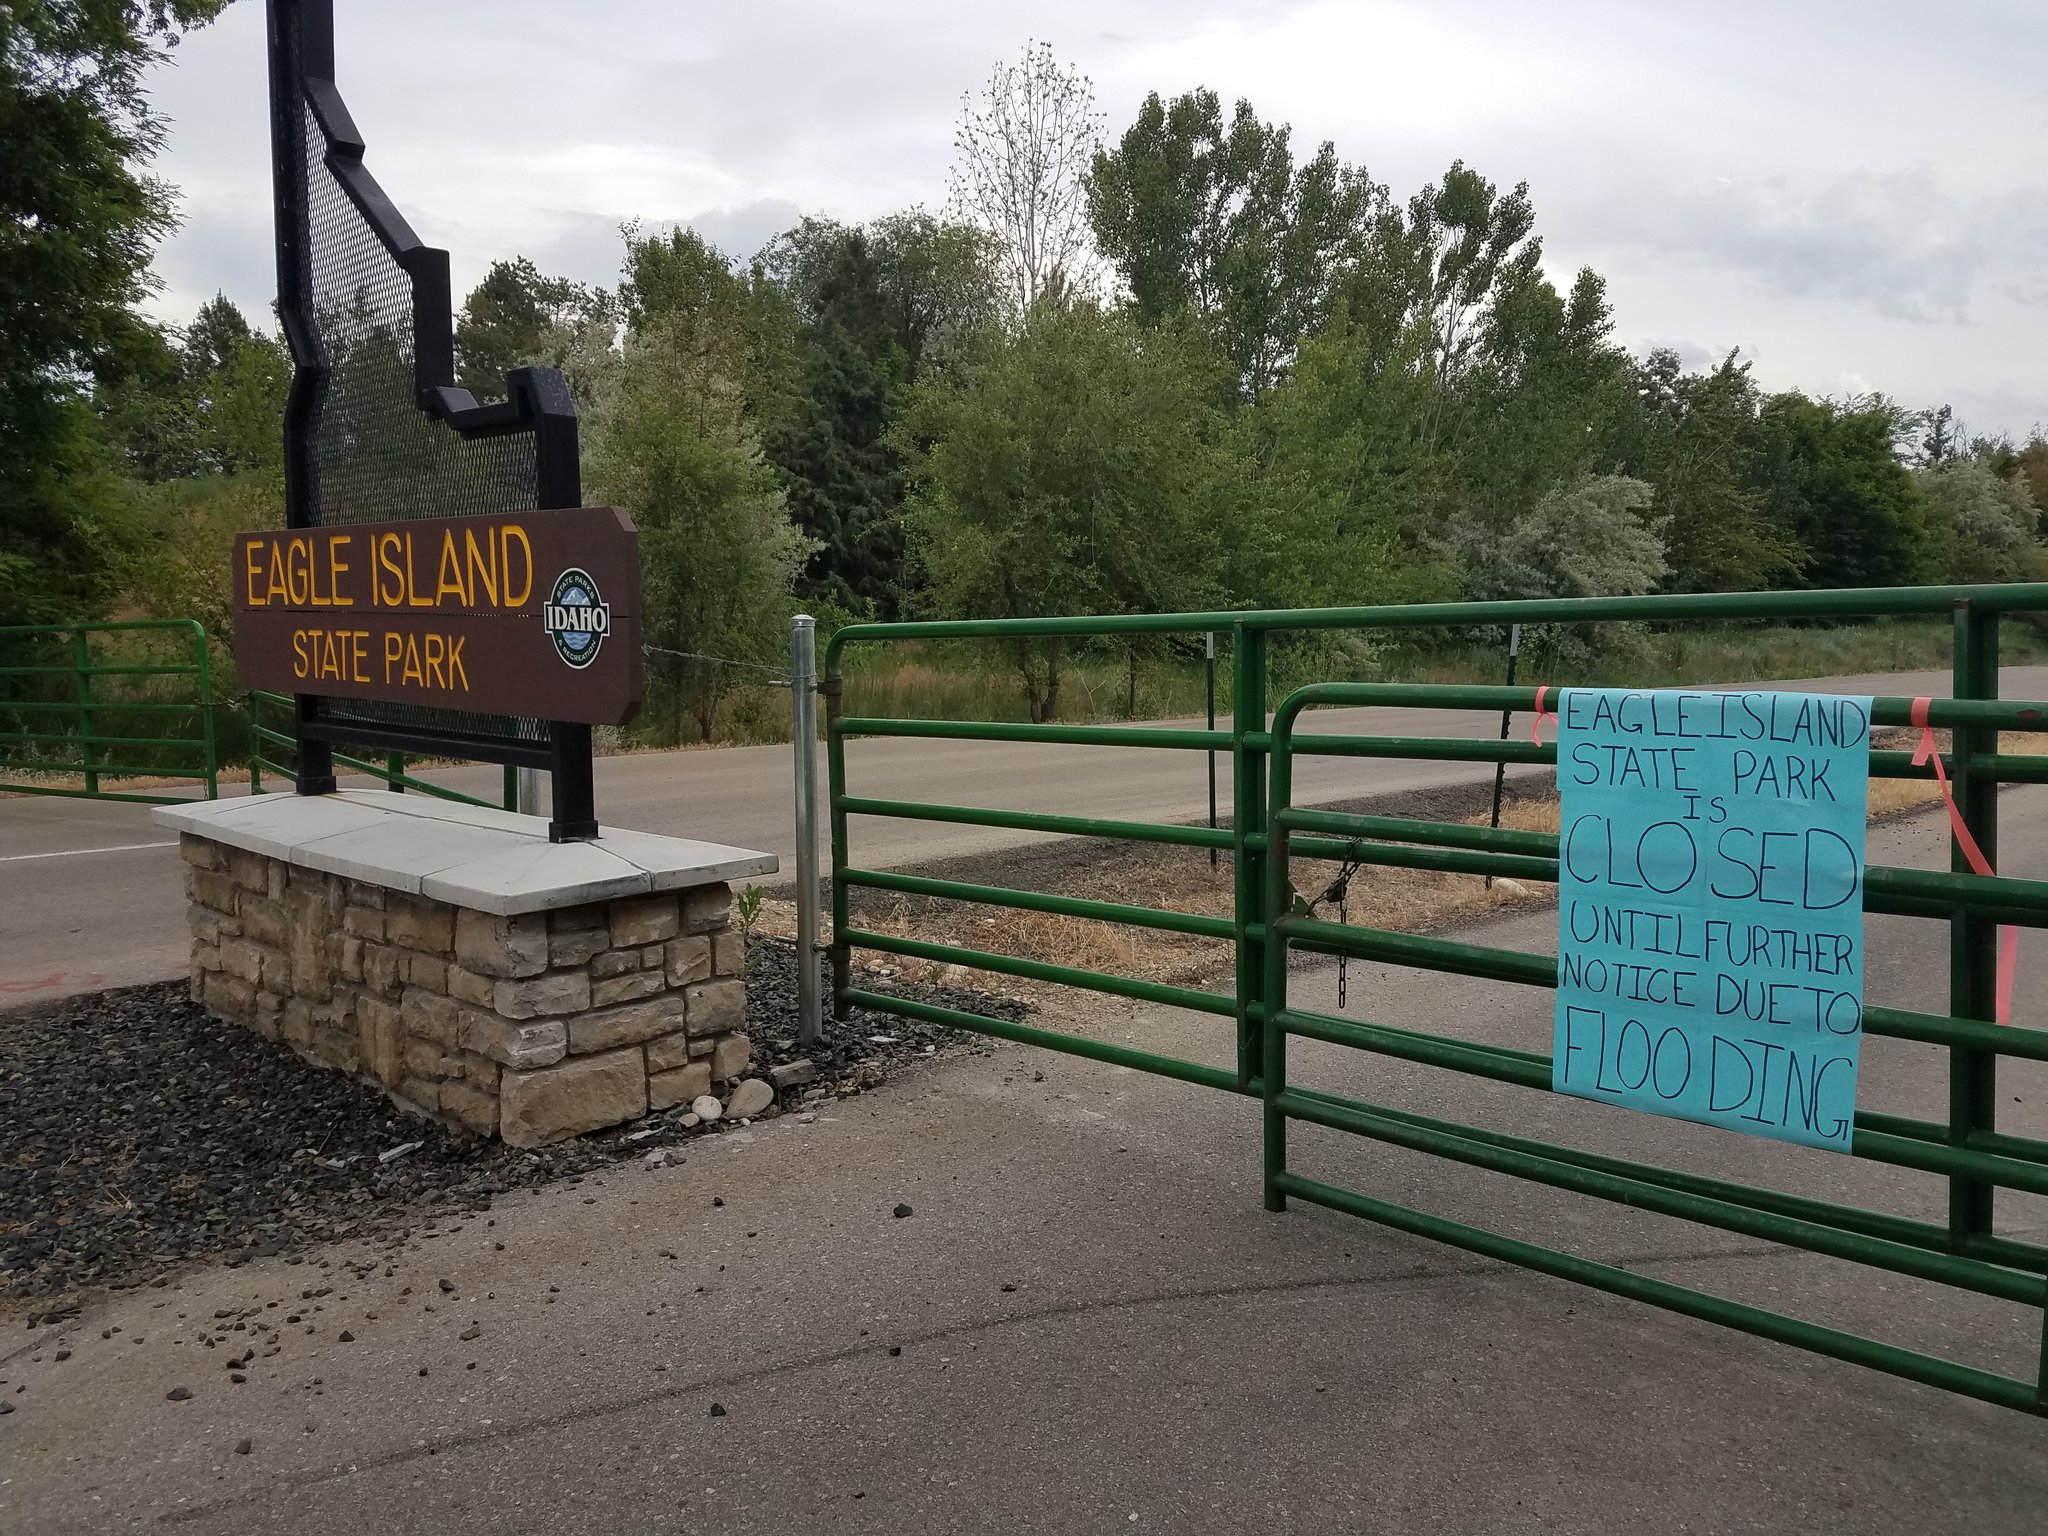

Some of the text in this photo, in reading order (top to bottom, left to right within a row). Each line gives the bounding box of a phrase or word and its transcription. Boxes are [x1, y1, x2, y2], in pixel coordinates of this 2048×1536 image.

[246, 524, 534, 608] EAGLE ISLAND
[556, 575, 595, 599] STATE PARKS
[547, 606, 607, 633] IDAHO
[293, 629, 469, 691] STATE PARK
[563, 641, 597, 661] RECREATION
[1567, 692, 1867, 749] EAGLE ISLAND
[1572, 743, 1836, 801] STATE PARK
[1683, 795, 1727, 823] IS
[1567, 815, 1858, 910] CLOSED
[1571, 900, 1853, 975] UNTIL FURTHER
[1563, 953, 1861, 1034] NOTICE DUE TO
